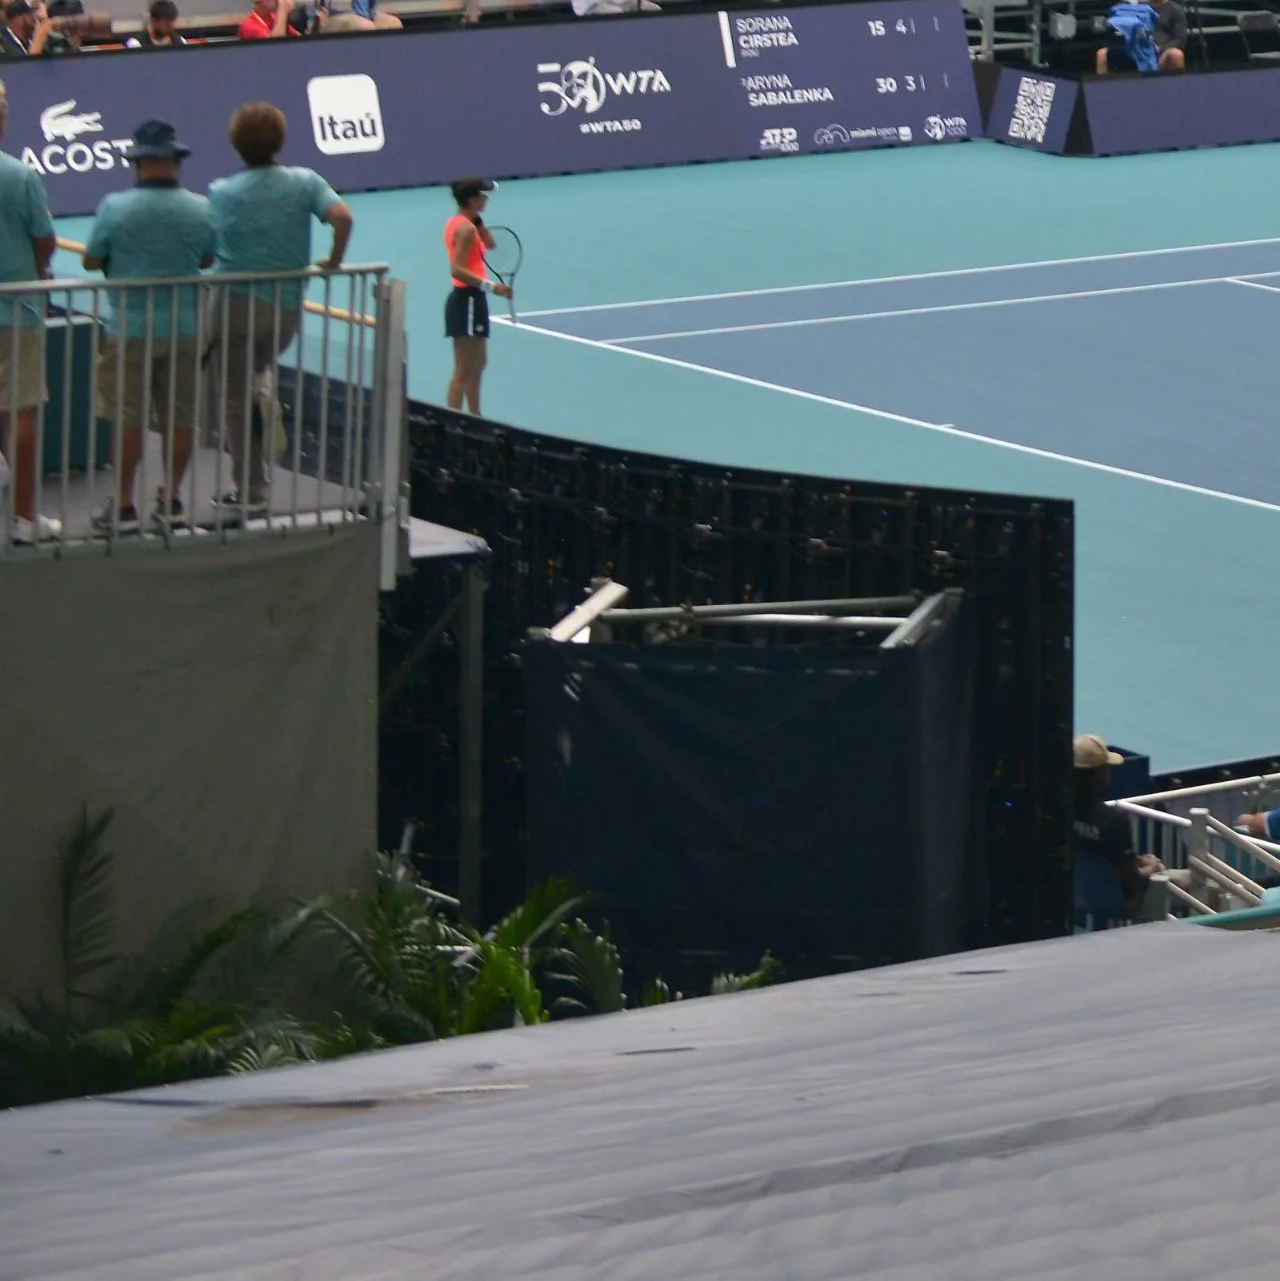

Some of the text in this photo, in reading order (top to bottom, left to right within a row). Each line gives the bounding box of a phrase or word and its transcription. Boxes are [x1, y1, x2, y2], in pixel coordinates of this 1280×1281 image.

[736, 16, 793, 34] SORANA
[867, 19, 907, 37] 15 4
[738, 32, 799, 50] CIRSTEA
[605, 69, 672, 96] WTA
[875, 75, 916, 94] 30 3
[748, 87, 834, 107] SABALENKA
[318, 112, 379, 142] Itaú
[579, 118, 642, 134] #WTA50
[760, 127, 798, 145] ATP
[20, 139, 135, 175] ACOST
